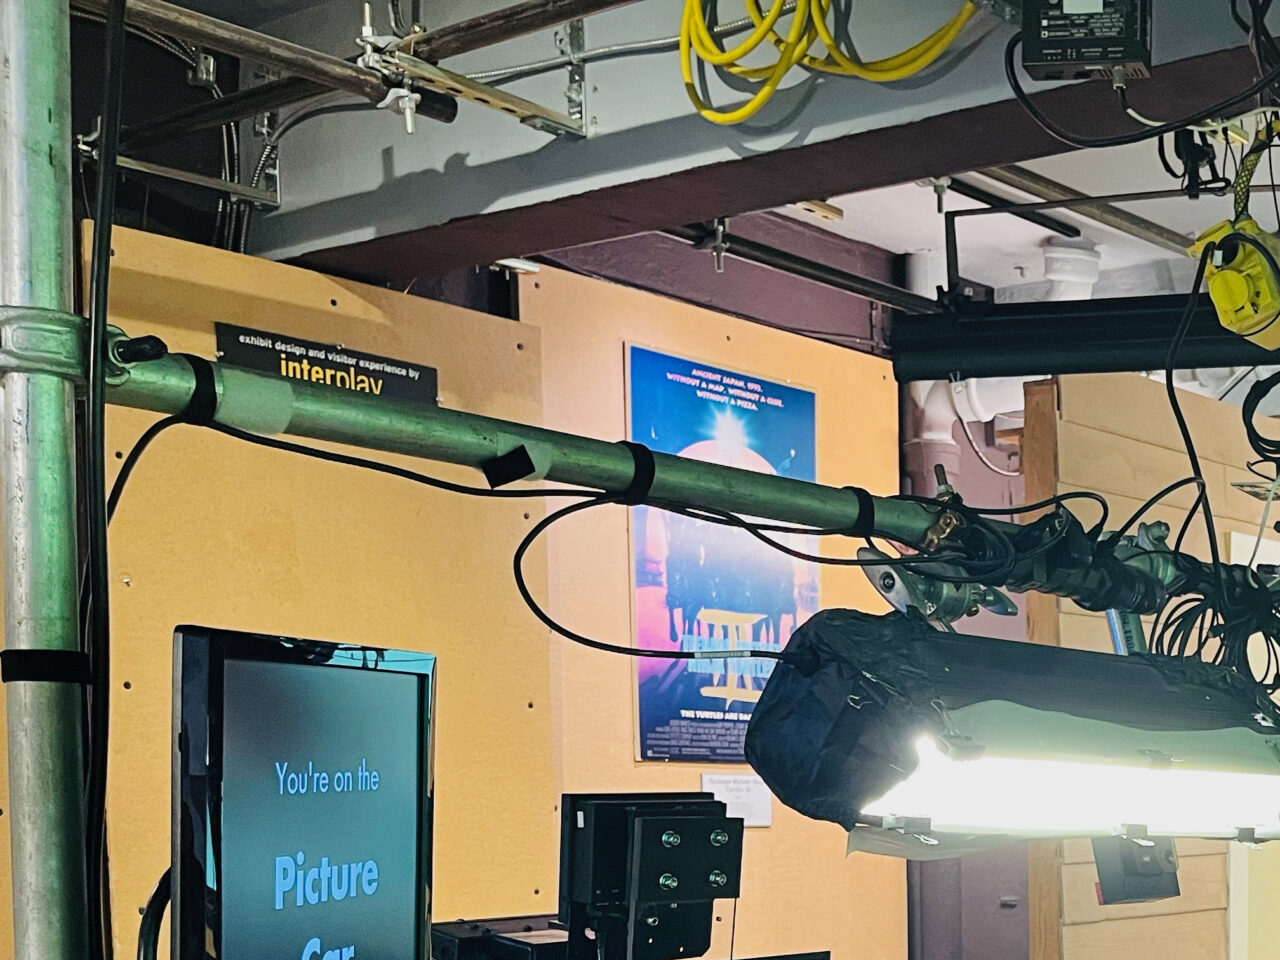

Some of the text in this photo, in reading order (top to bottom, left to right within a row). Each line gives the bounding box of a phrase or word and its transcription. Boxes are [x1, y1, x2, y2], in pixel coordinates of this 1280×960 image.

[239, 334, 420, 381] exhibit design and visitor experience by
[666, 372, 700, 387] WITHOUT
[701, 381, 707, 389] A
[728, 387, 760, 402] WITHOUT
[760, 395, 766, 403] A
[692, 369, 722, 382] ANCIENT
[696, 390, 729, 404] WITHOUT
[730, 397, 736, 406] A
[680, 709, 695, 719] THE
[696, 710, 724, 720] TURTLES
[724, 711, 738, 720] ARE
[275, 758, 380, 794] You're on the
[274, 851, 379, 910] Picture
